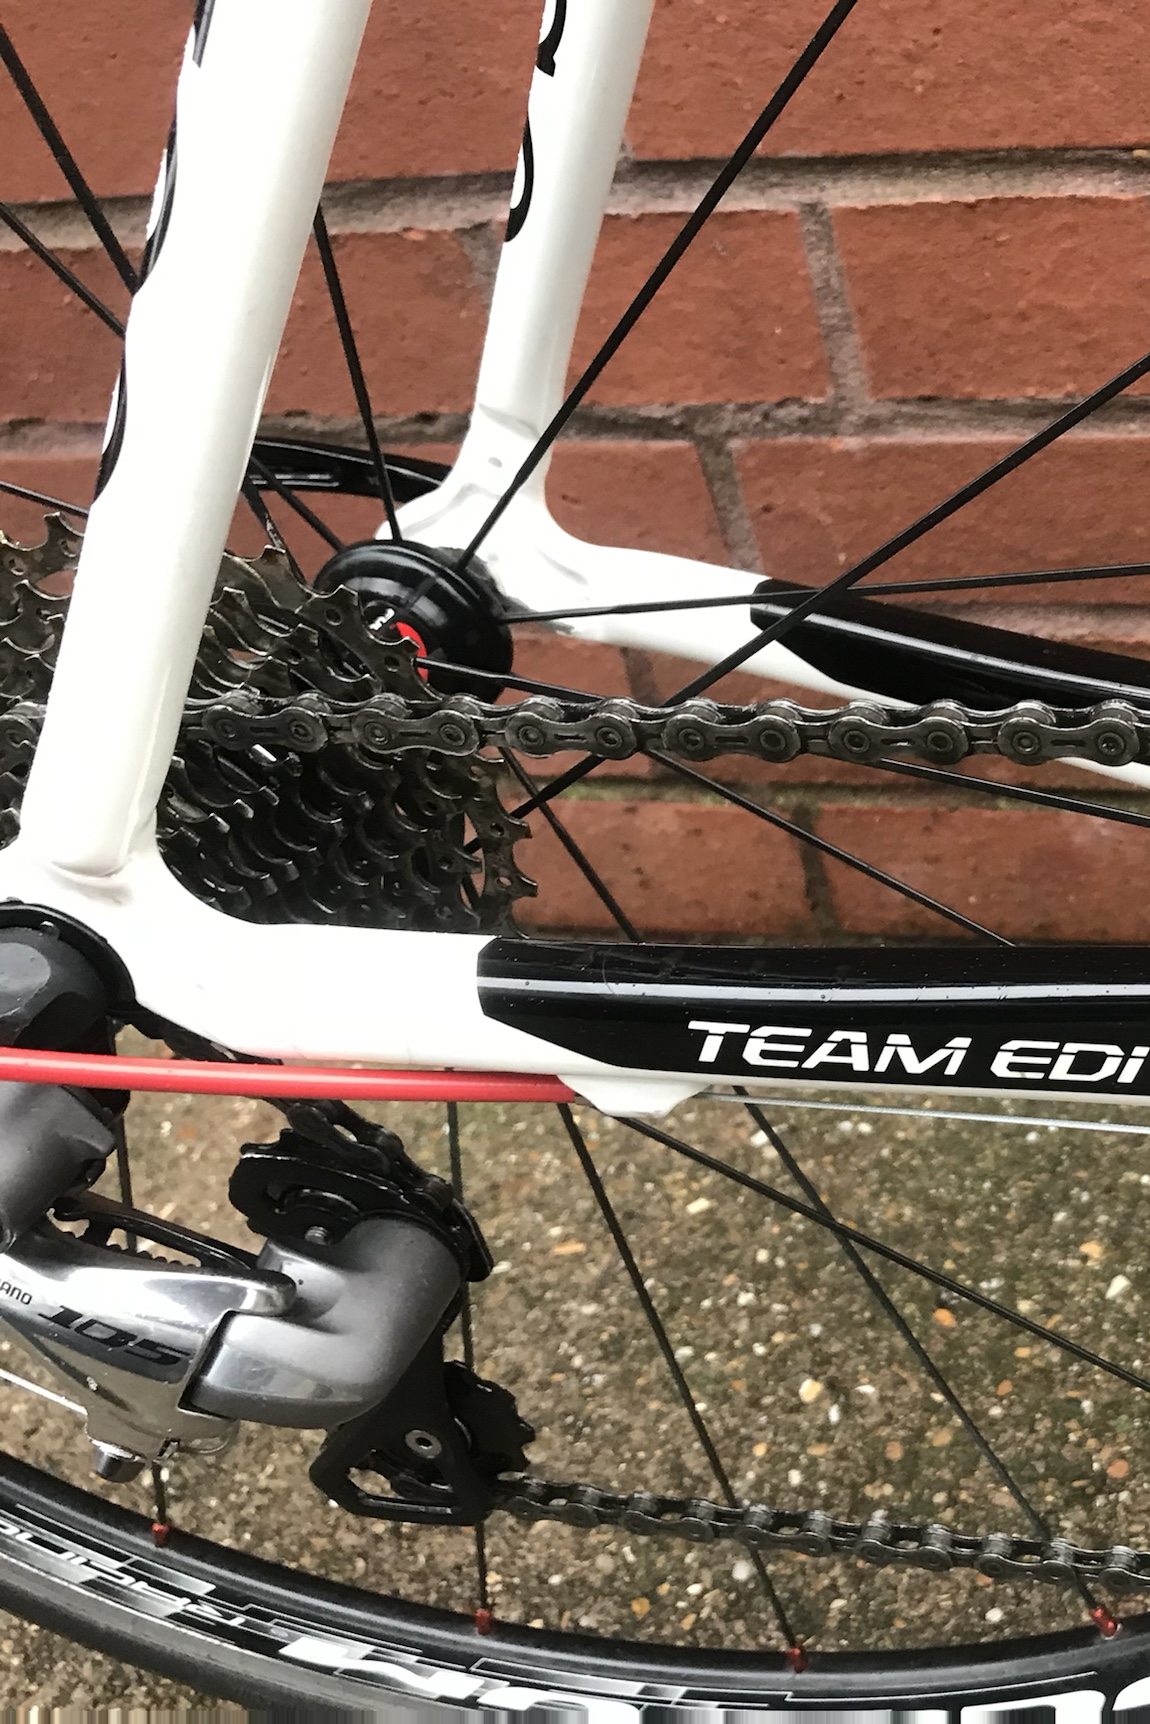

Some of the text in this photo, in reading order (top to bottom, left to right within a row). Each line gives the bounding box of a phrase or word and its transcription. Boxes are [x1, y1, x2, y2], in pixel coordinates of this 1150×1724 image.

[687, 1020, 972, 1076] TEAM
[0, 1279, 33, 1305] ANO
[37, 1305, 191, 1365] 105
